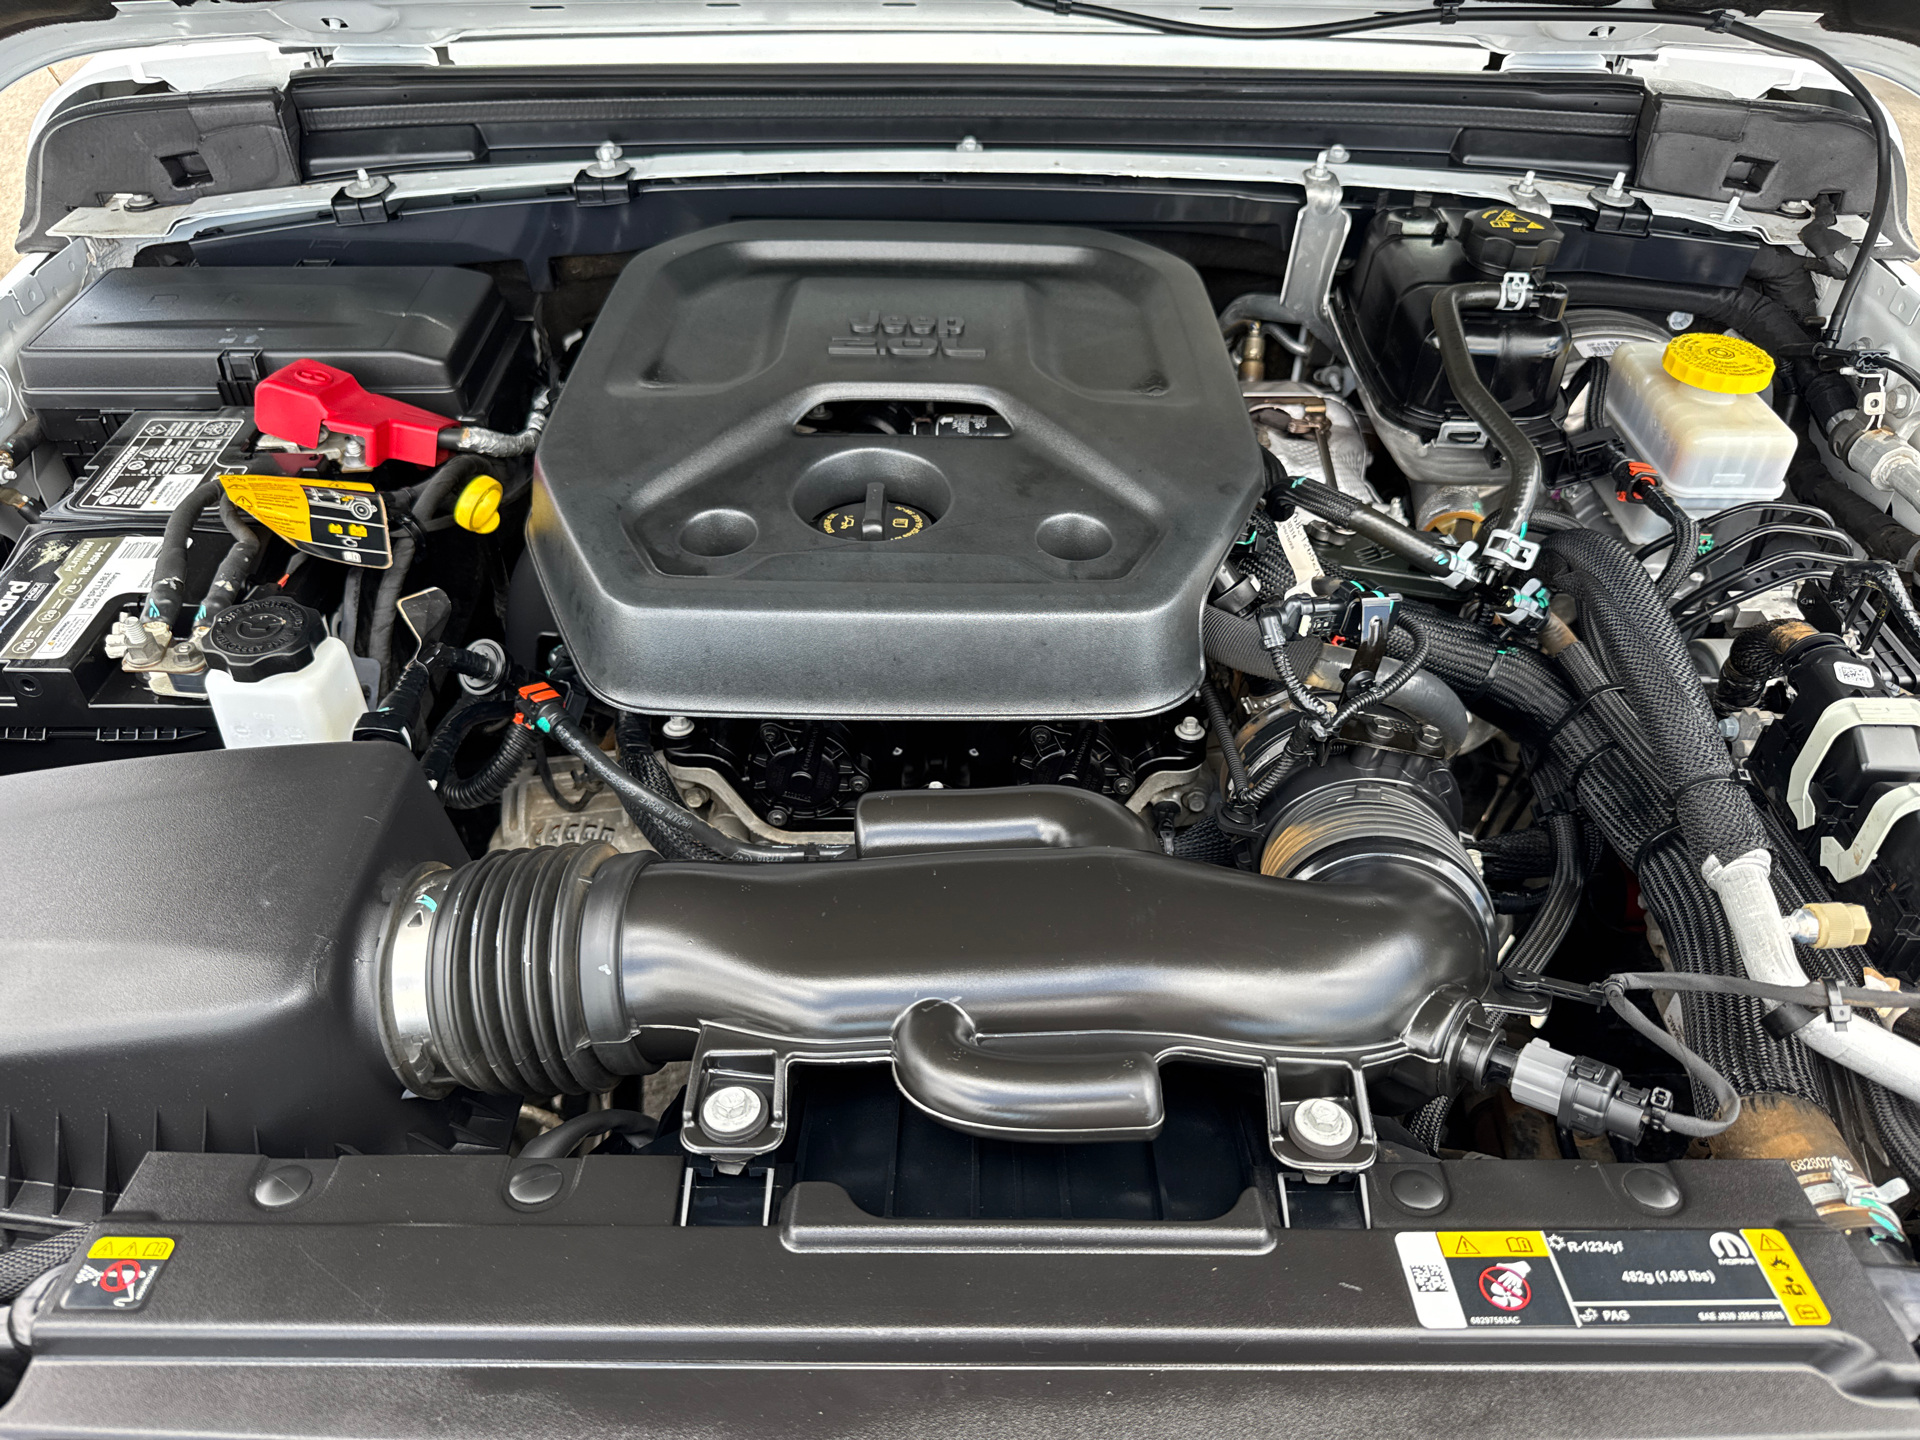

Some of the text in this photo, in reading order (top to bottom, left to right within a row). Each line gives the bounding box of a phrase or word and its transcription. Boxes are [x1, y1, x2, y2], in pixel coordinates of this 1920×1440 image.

[850, 310, 965, 337] Jeep
[65, 541, 95, 572] PLATINUM
[65, 583, 76, 594] 70
[41, 609, 58, 621] 120
[17, 639, 33, 652] 760
[640, 795, 665, 815] BRAKE
[666, 809, 693, 830] VACUUM
[1790, 1156, 1854, 1172] 682807AD
[1567, 1240, 1624, 1255] R-1234yf
[1688, 1269, 1716, 1284] lbs)
[1602, 1309, 1630, 1321] PAG
